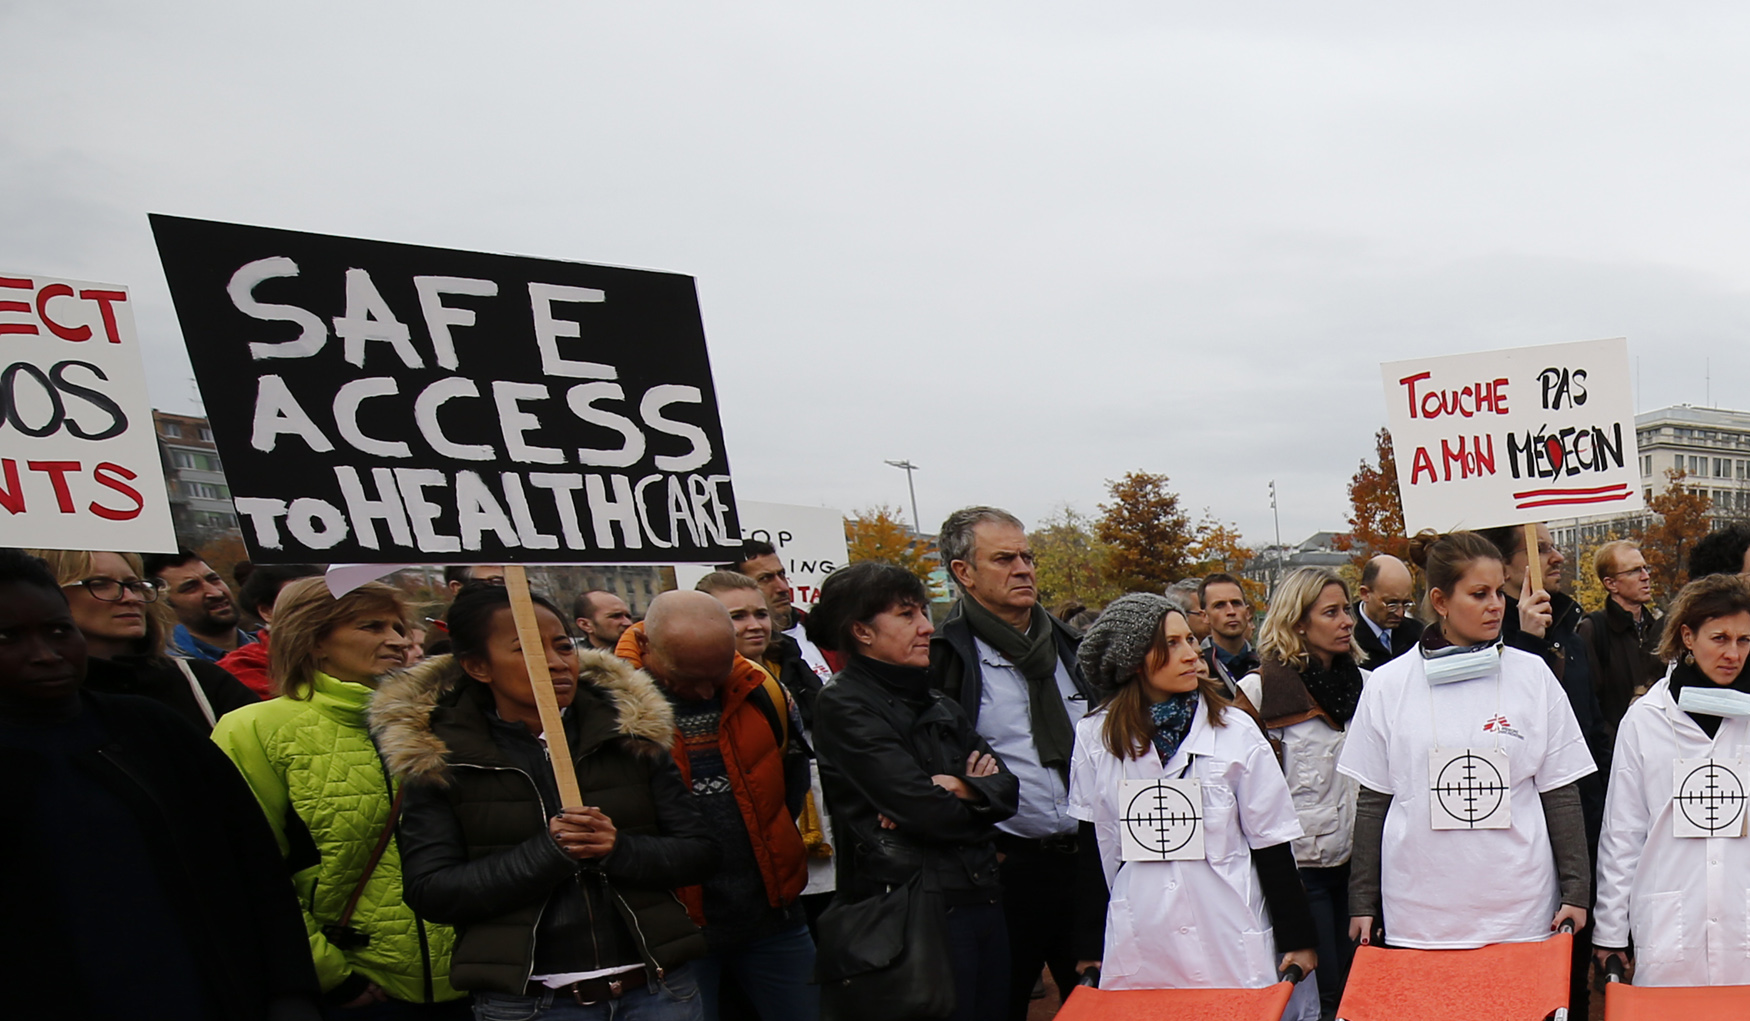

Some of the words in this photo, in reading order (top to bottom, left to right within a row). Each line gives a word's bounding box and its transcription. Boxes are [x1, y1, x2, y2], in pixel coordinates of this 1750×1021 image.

[0, 276, 127, 344] ECT
[227, 256, 617, 379] SAFE
[0, 360, 129, 441] OS
[250, 375, 712, 470] ACCESS
[1400, 372, 1509, 418] TOUCHE
[1537, 367, 1587, 410] PAS
[0, 458, 144, 521] NTS
